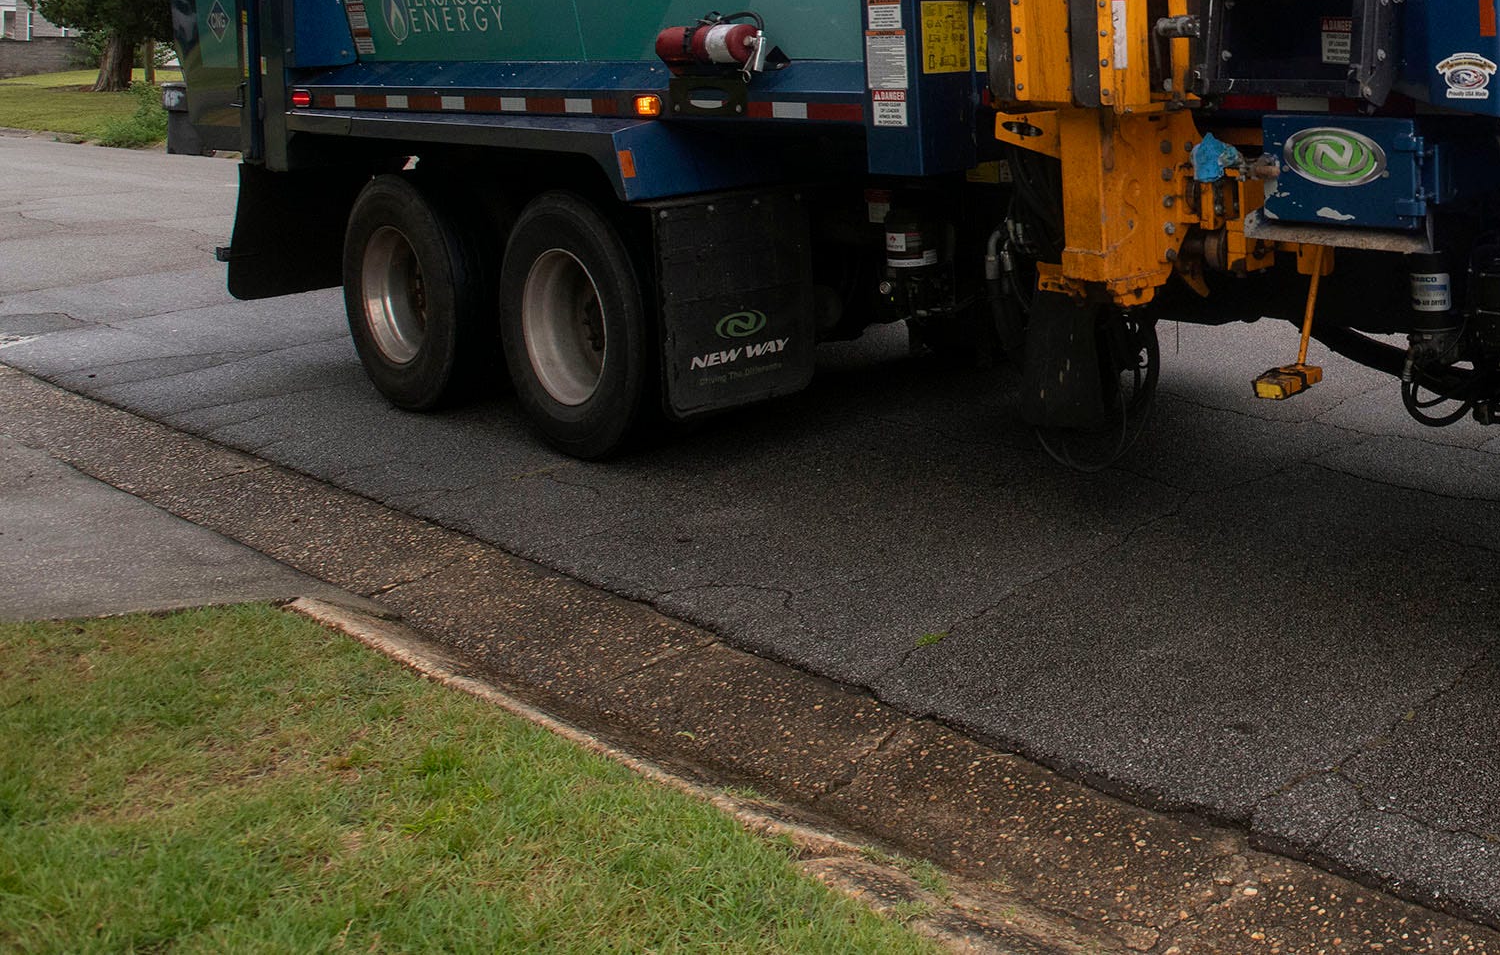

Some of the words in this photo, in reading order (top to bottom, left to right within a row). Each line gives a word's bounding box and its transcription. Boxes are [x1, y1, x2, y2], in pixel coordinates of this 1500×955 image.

[211, 12, 227, 28] CNG
[408, 5, 503, 33] ENERGY
[881, 91, 905, 100] DANGER
[690, 347, 743, 370] NEW
[746, 337, 790, 358] WAY
